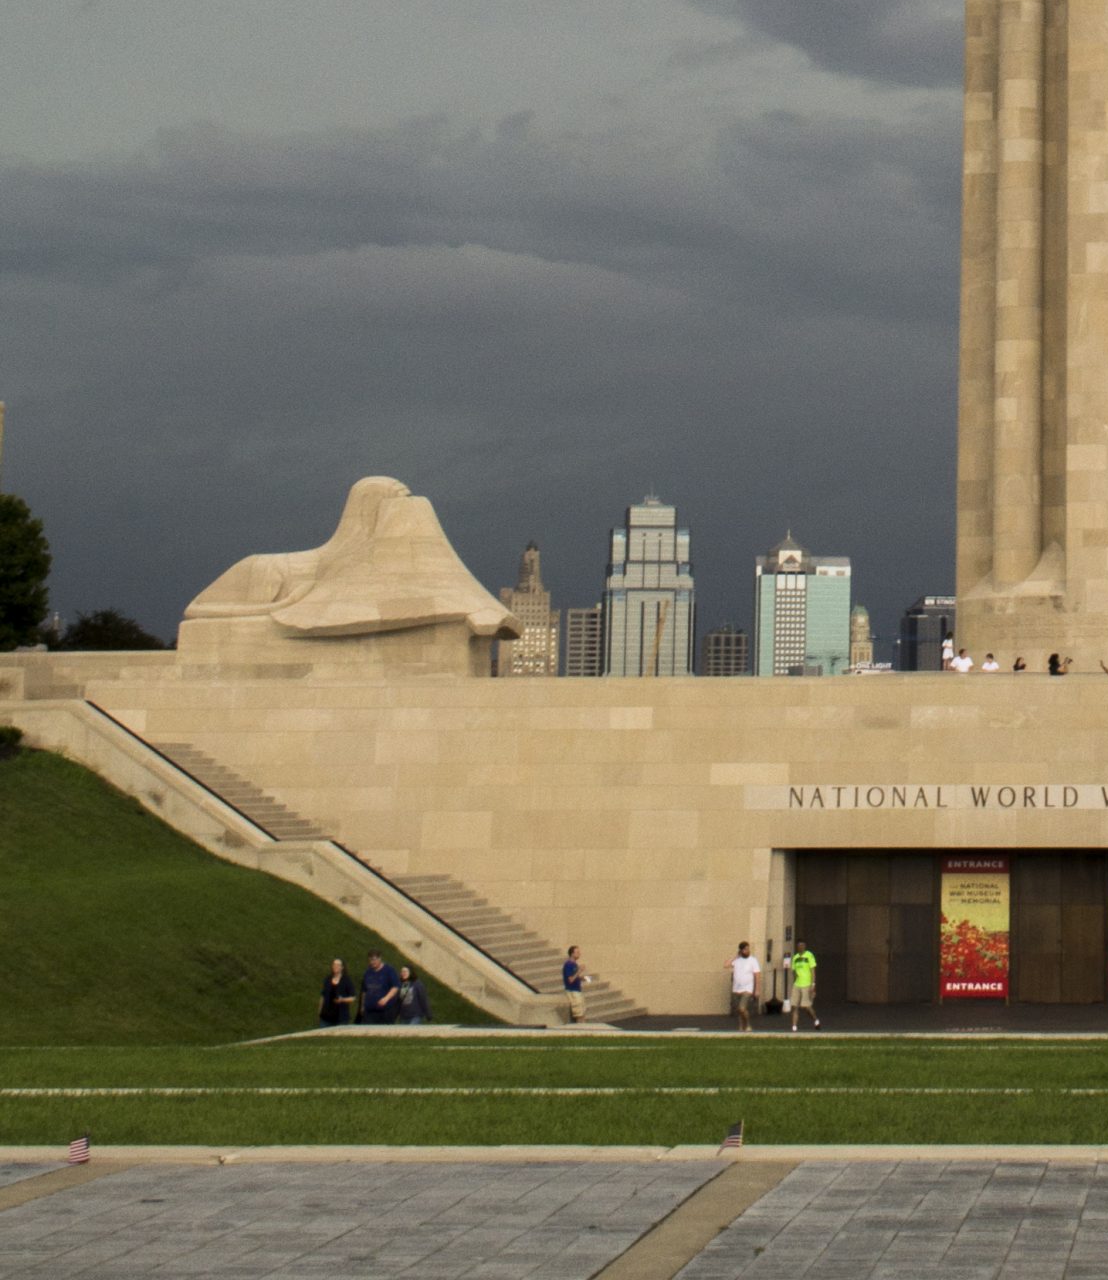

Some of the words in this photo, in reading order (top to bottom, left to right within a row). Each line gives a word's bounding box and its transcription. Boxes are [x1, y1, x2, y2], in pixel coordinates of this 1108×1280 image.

[789, 786, 948, 808] NATIONAL
[971, 786, 1079, 808] WORLD
[948, 860, 1004, 868] ENTRANCE
[946, 982, 1003, 991] ENTRANCE
